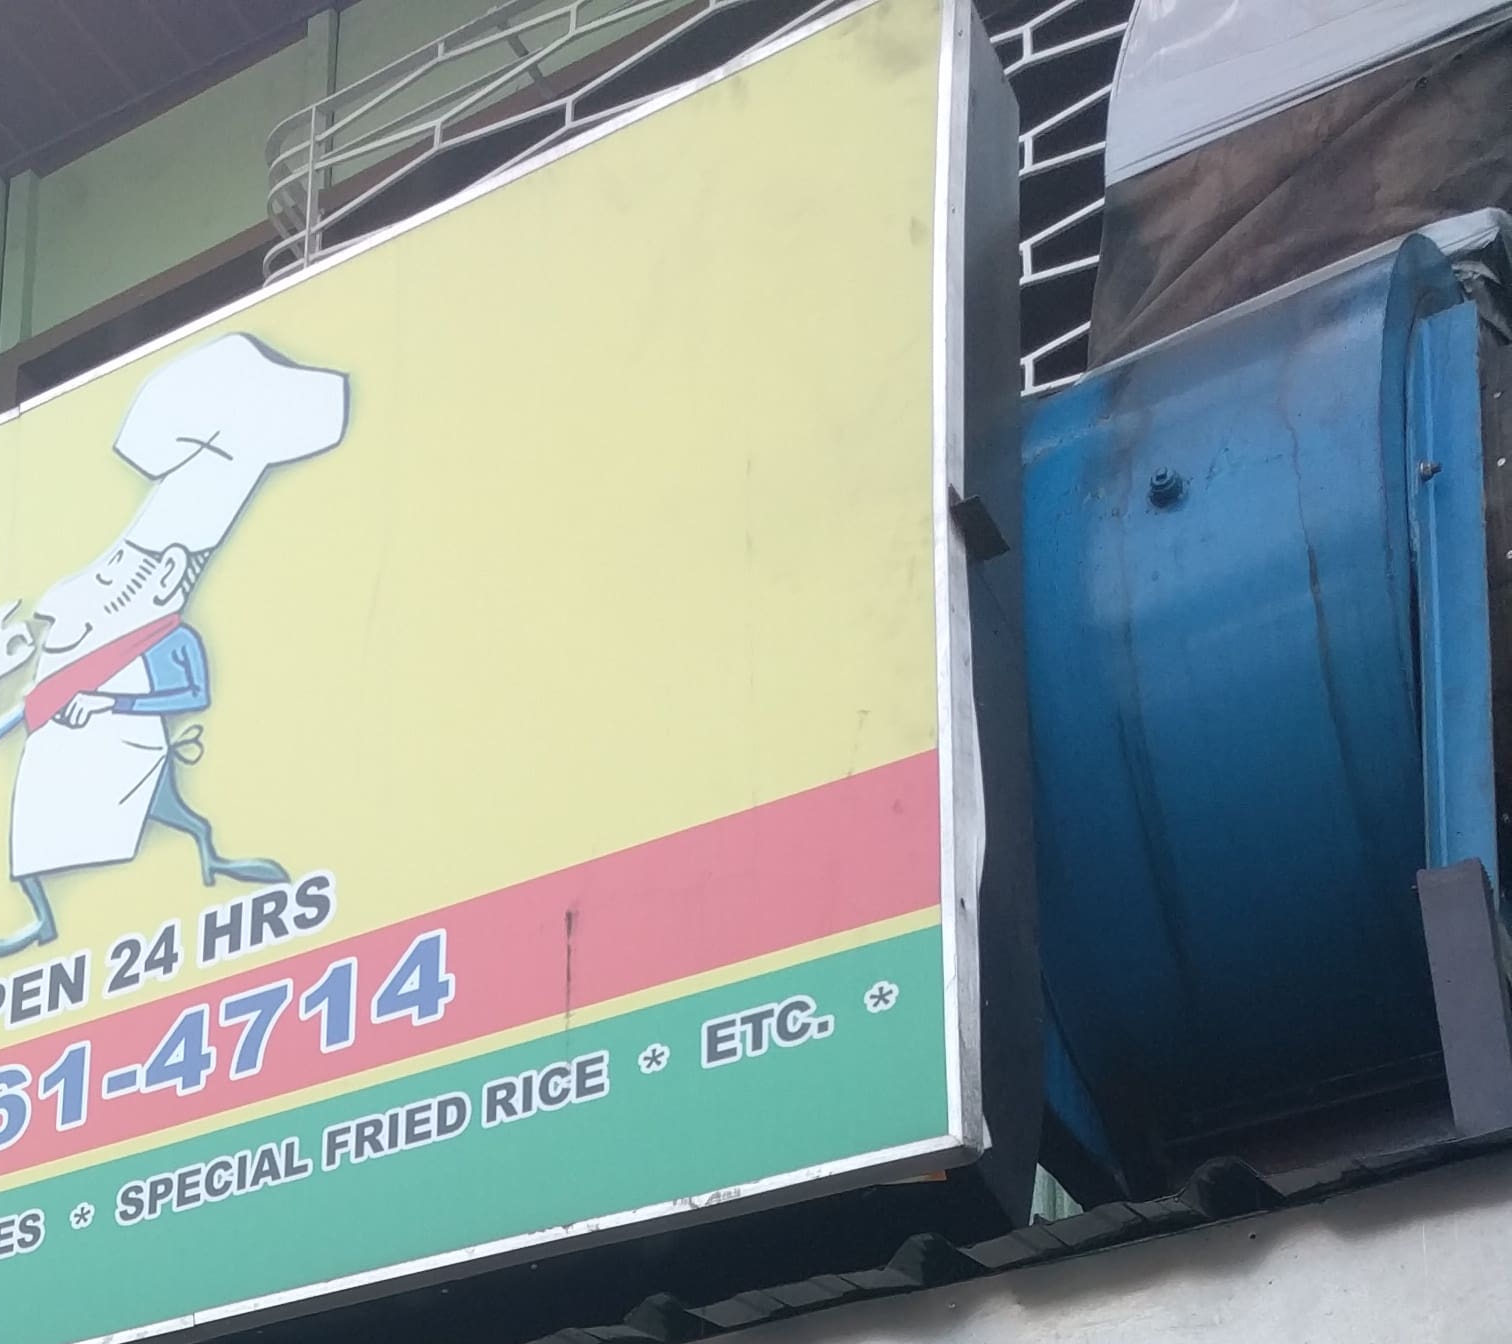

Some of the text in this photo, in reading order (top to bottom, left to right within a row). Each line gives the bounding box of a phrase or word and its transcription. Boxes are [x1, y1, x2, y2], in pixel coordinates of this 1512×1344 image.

[106, 924, 179, 994] 24
[201, 876, 332, 962] HRS
[117, 1139, 311, 1224] SPECIAL
[324, 1096, 468, 1168] FRIED
[484, 1051, 609, 1126] RICE
[702, 996, 834, 1067] ETC.
